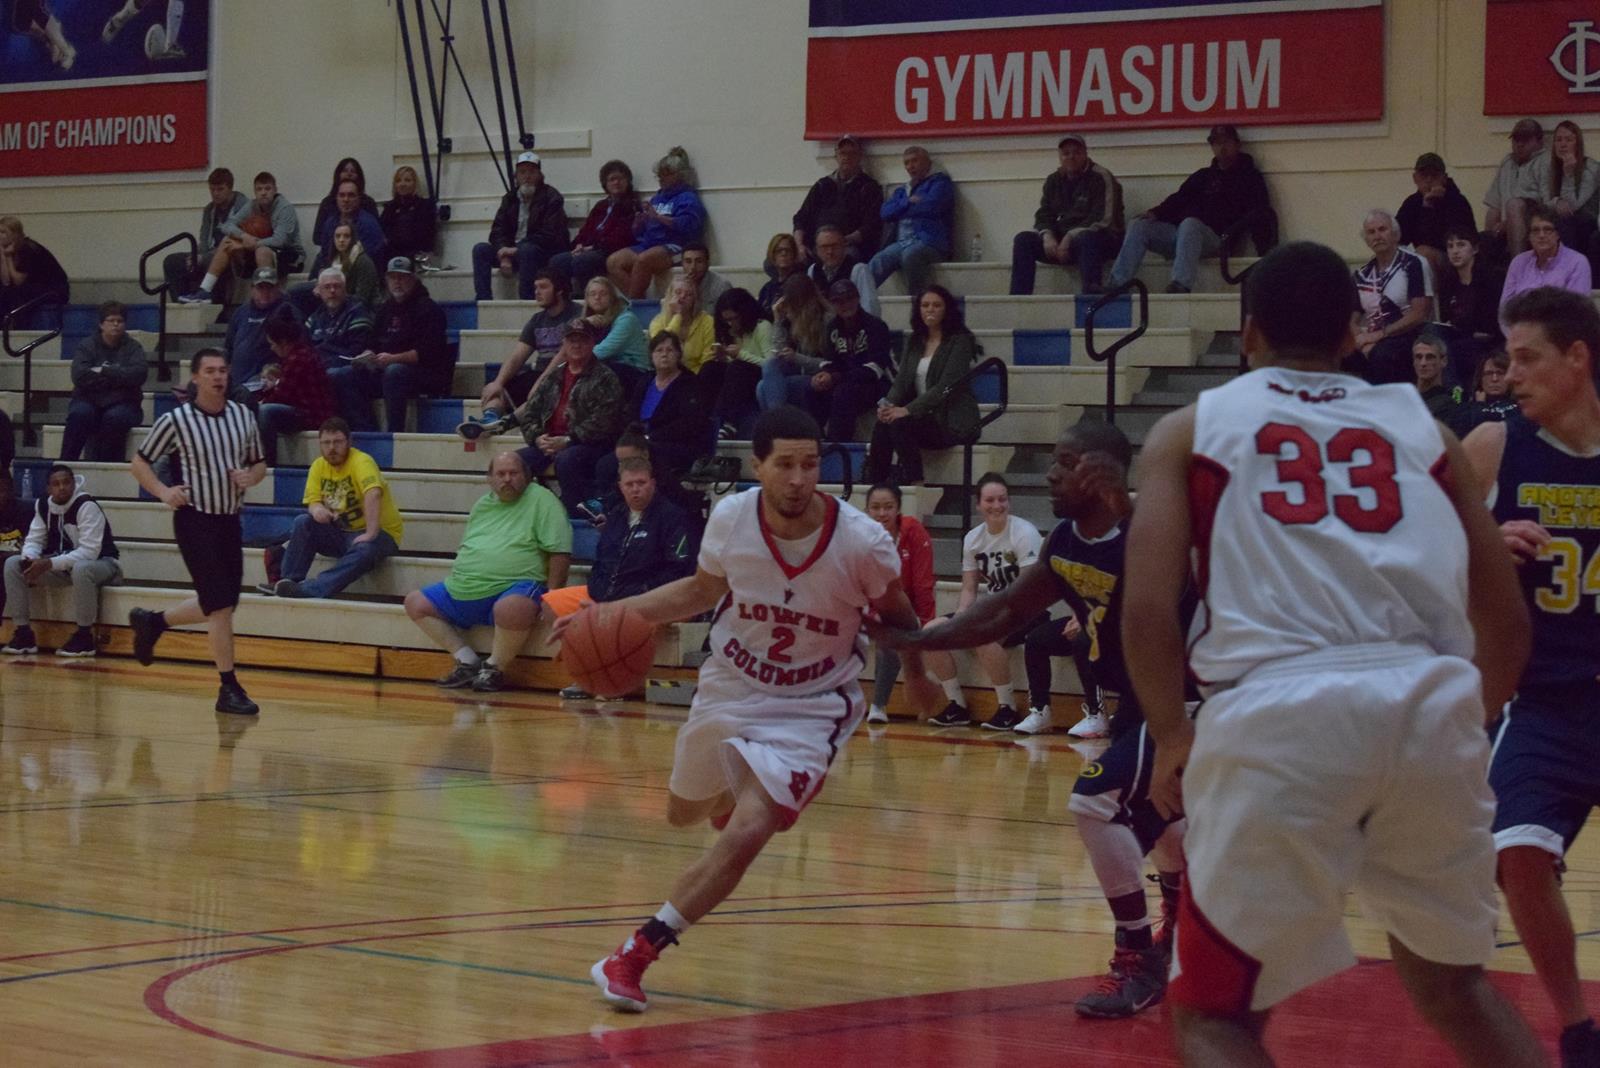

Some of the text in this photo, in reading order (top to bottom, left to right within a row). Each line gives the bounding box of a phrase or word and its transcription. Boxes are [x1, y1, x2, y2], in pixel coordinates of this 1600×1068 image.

[894, 38, 1281, 124] GYMNASIUM
[27, 120, 50, 149] OF
[55, 113, 176, 149] CHAMPIONS
[1255, 422, 1404, 534] 33
[1518, 483, 1600, 507] ANOT
[738, 603, 840, 636] LOWER
[723, 638, 836, 686] COLUMBIA
[767, 626, 796, 664] 2
